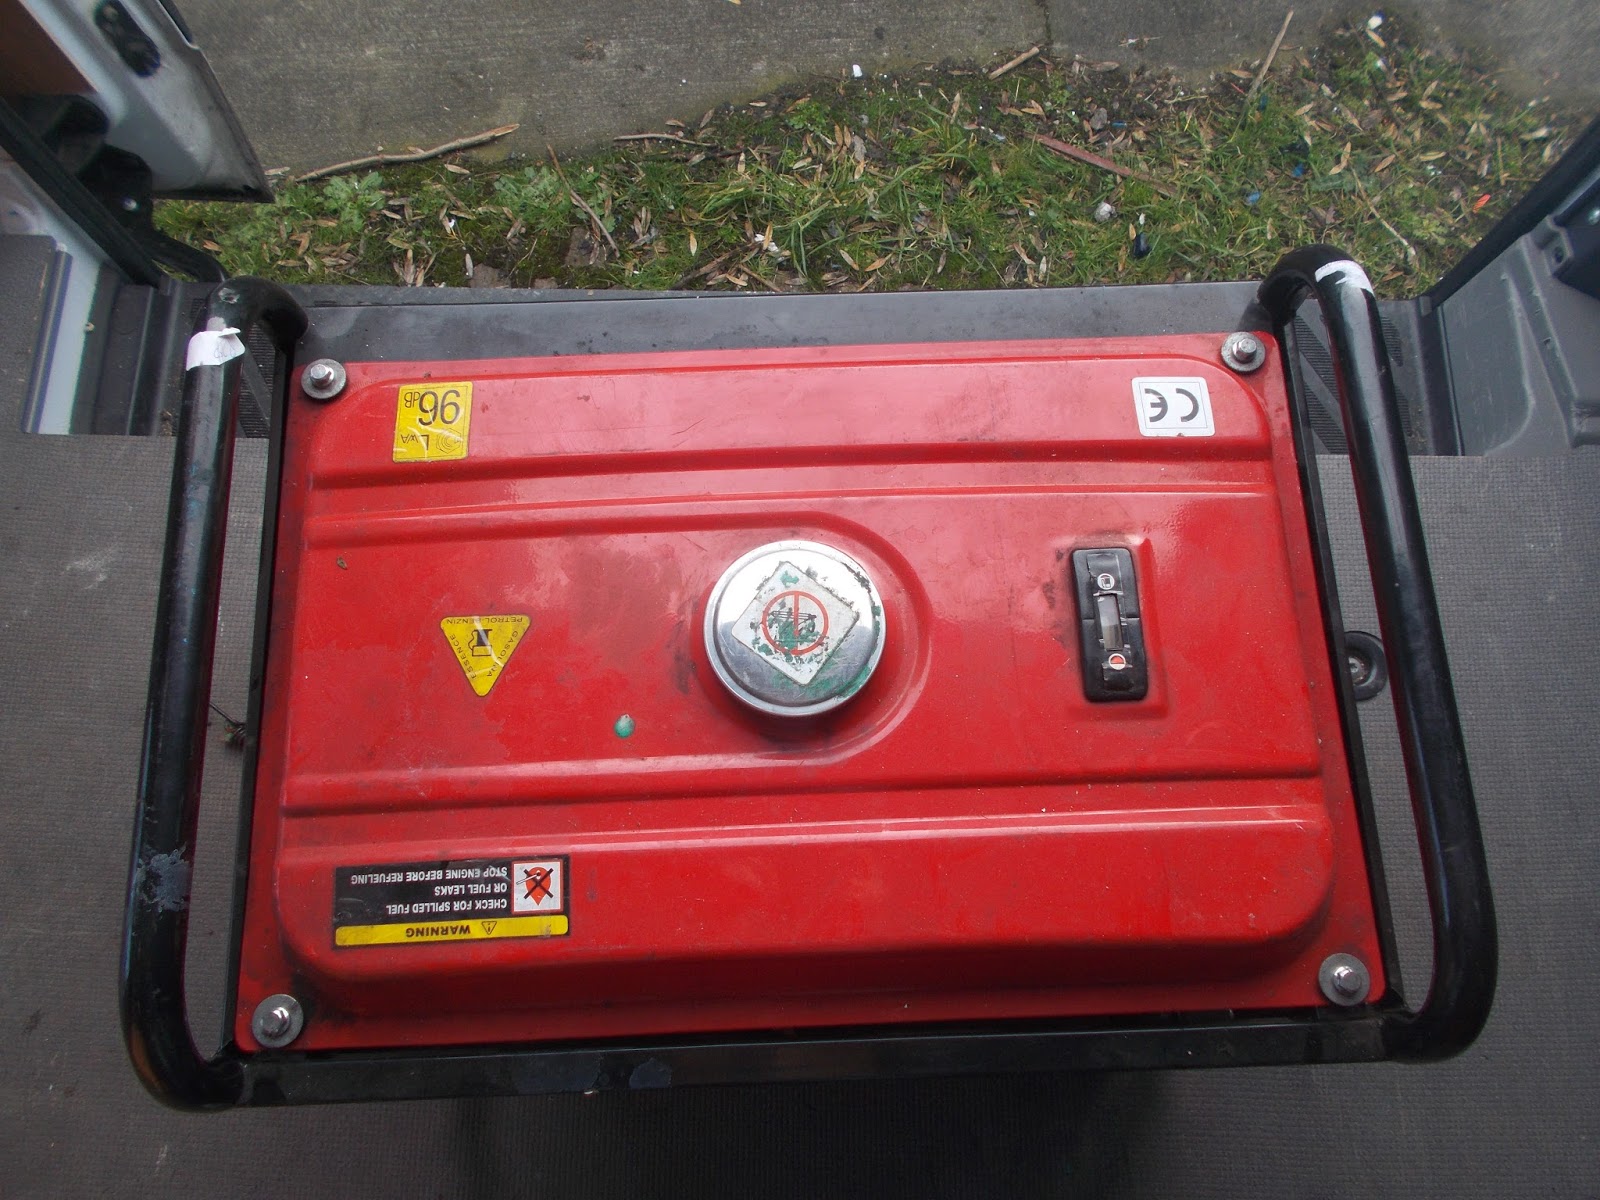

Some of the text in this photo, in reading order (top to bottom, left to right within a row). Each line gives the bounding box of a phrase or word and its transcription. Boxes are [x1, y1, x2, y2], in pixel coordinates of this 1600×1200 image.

[1144, 388, 1199, 423] CE
[485, 616, 523, 625] PETROL
[449, 633, 477, 679] ESSENCE
[351, 866, 508, 885] STOP ENGINE BEFORE REFUELING
[434, 882, 508, 896] OR FUEL LEAKS
[386, 898, 507, 915] CHECK FOR SPILLED FUEL
[405, 924, 471, 938] WARNING
